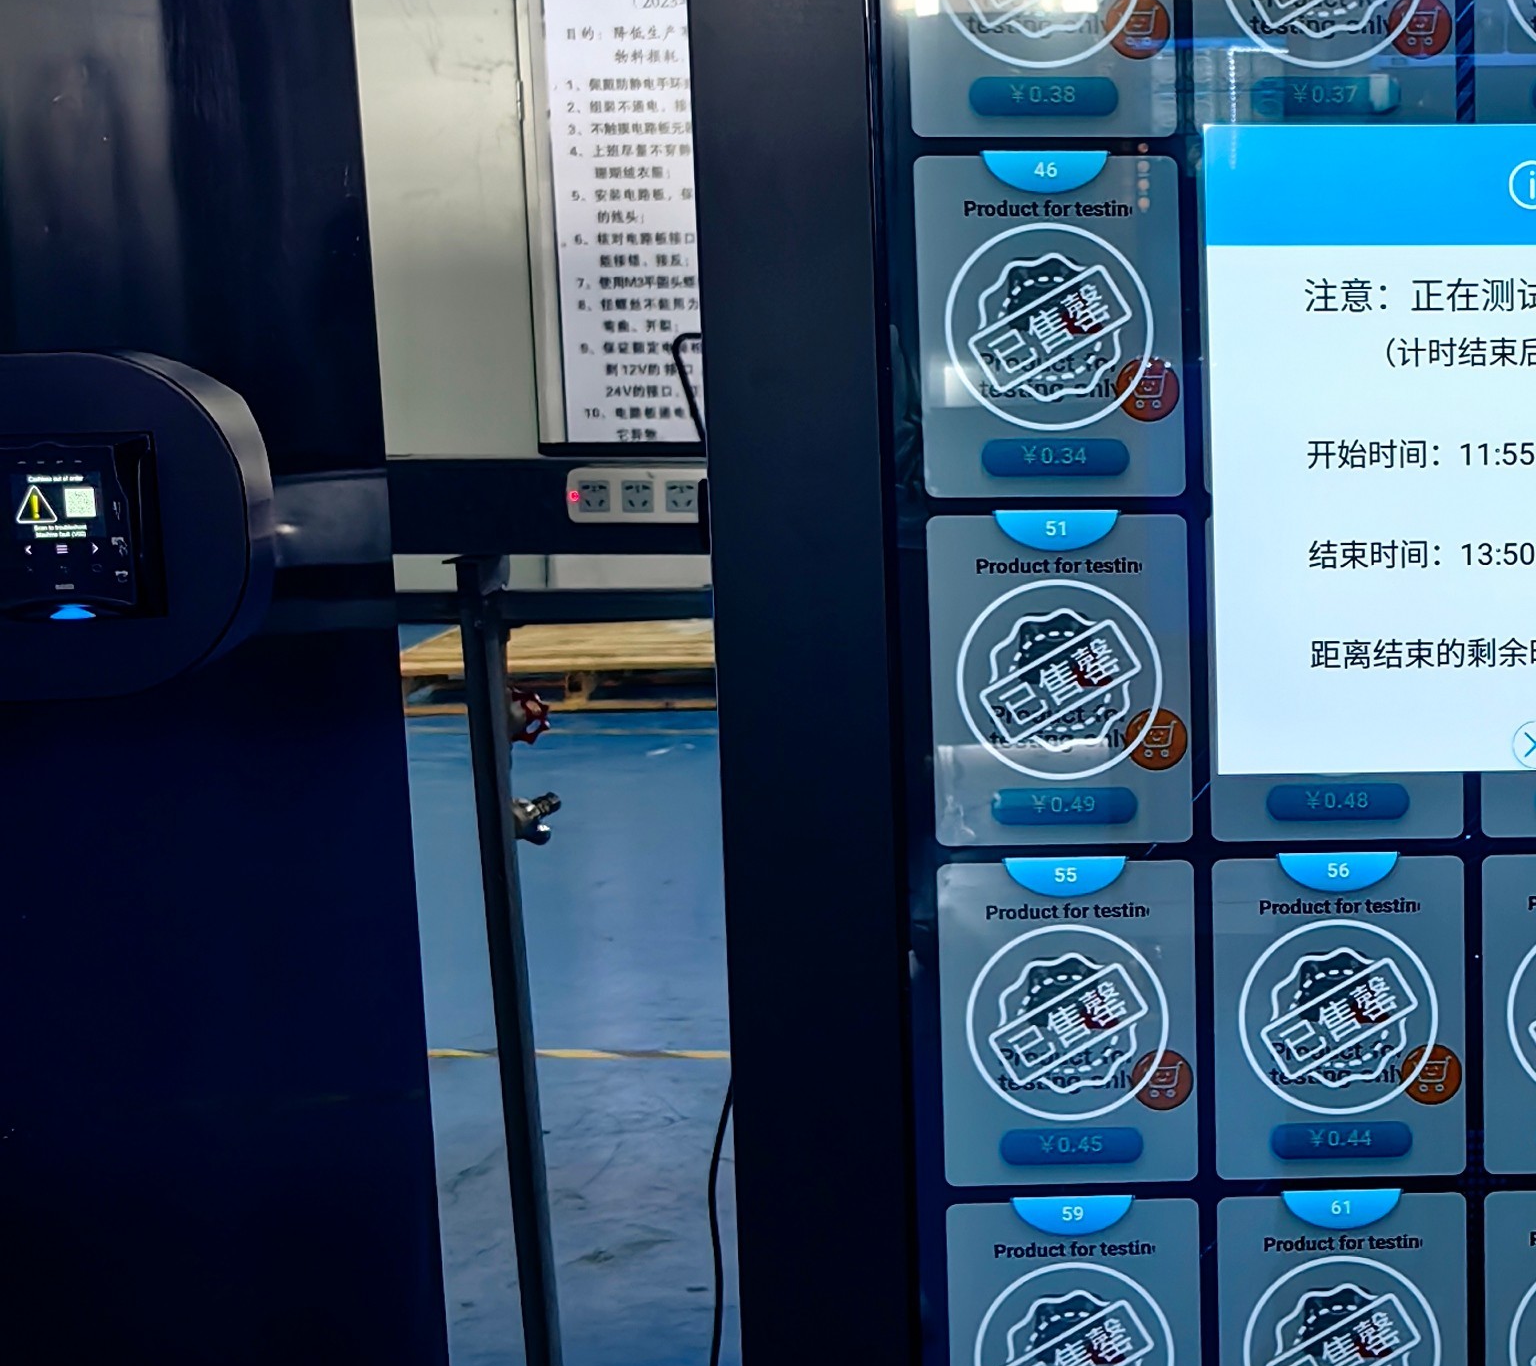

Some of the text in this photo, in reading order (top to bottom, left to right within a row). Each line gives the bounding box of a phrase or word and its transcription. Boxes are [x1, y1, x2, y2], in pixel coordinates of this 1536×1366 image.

[1009, 83, 1076, 103] ¥0.38
[1292, 83, 1358, 103] ¥0.37
[1034, 162, 1057, 177] 46
[964, 200, 1132, 216] Product for testin
[988, 284, 1111, 374] 已售罄
[1022, 445, 1087, 464] ¥0.34
[1046, 521, 1067, 536] 51
[977, 557, 1142, 574] Product for testin
[999, 638, 1119, 725] 已售罄
[1032, 795, 1095, 813] ¥0.49
[1305, 791, 1369, 809] ¥0.48
[1054, 867, 1077, 883] 55
[1327, 863, 1349, 878] 56
[986, 902, 1149, 920] Product for testin
[1260, 897, 1420, 915] Product for testin
[1007, 981, 1128, 1067] 已售罄
[1281, 976, 1398, 1061] 已售罄
[1040, 1135, 1103, 1154] ¥0.45
[1309, 1129, 1372, 1147] ¥0.44
[1062, 1206, 1084, 1221] 59
[1331, 1200, 1351, 1215] 61
[994, 1240, 1155, 1258] Product for testin
[1264, 1234, 1422, 1252] Product for testin
